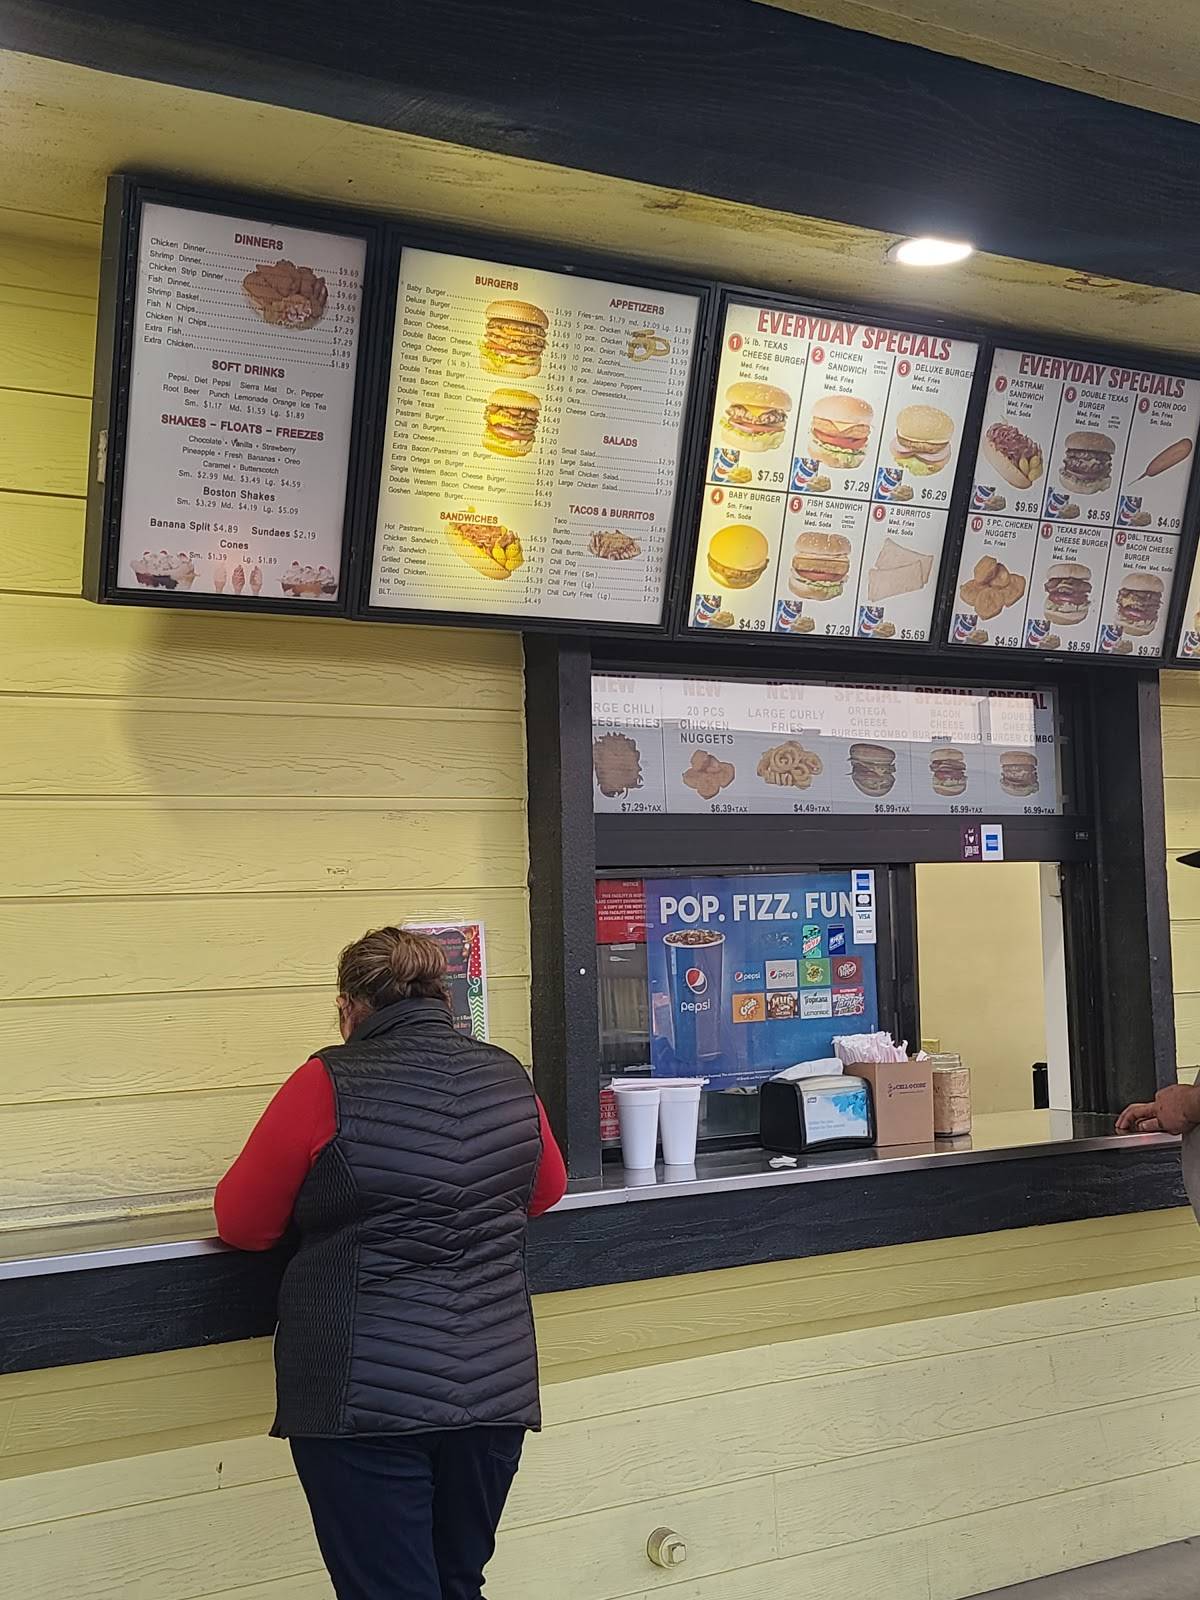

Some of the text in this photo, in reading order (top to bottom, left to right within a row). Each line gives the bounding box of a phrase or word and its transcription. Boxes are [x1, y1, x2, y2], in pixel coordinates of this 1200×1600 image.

[151, 238, 206, 253] Chicken Dinner
[235, 234, 283, 250] DINNERS
[150, 250, 201, 264] Shrimp Dinner
[149, 263, 223, 280] Chicken Strip Dinner
[475, 276, 518, 291] BURGERS
[407, 284, 445, 296] Baby Burger
[147, 300, 161, 309] Fish
[176, 303, 195, 313] Chips
[610, 299, 664, 315] APPETIZERS
[405, 307, 449, 319] Double Burger
[757, 310, 951, 361] EVERYDAY SPECIALS
[144, 337, 193, 349] Extra Chicken
[732, 337, 738, 348] 1
[752, 338, 760, 347] lb.
[764, 340, 788, 351] TEXAS
[742, 350, 805, 365] CHEESE BURGER
[814, 350, 863, 363] 2 CHICKEN
[212, 360, 284, 378] SOFT DRINKS
[741, 362, 769, 371] Med. Fries
[828, 363, 867, 376] SANDWICH
[900, 364, 974, 379] 3 DELUXE BURGER
[739, 371, 768, 381] Med. Soda
[1019, 354, 1185, 398] EVERYDAY SPECIALS
[999, 380, 1044, 390] 7 PASTRAMI
[1009, 390, 1043, 401] SANDWICH
[1068, 390, 1128, 403] 8 DOUBLE TEXAS
[1079, 401, 1105, 411] BURGER
[1142, 401, 1186, 412] 9 CORN DOG
[161, 414, 324, 441] SHAKES FLOATS FREEZES
[394, 431, 435, 442] Extra Cheese
[603, 435, 637, 447] SALADS
[189, 436, 296, 454] Chocolate Vanilla Strawberry
[562, 448, 576, 456] Small
[758, 470, 783, 482] $7.59
[844, 480, 869, 492] $7.29
[203, 487, 275, 502] Boston Shakes
[714, 491, 780, 503] 4 BABY BURGER
[921, 488, 947, 500] $6.29
[196, 499, 216, 508] $3.29
[221, 502, 234, 510] Md.
[239, 502, 257, 512] $4.19
[263, 505, 273, 514] Lg.
[279, 506, 298, 515] $5.09
[793, 499, 863, 511] 5 FISH SANDWICH
[1015, 502, 1038, 513] $9.69
[440, 512, 498, 524] SANDWICHES
[569, 505, 654, 520] TACOS & BURRITOS
[877, 509, 882, 518] 6
[896, 509, 931, 518] BURRITOS
[1088, 510, 1110, 521] $8.59
[150, 519, 238, 533] Banana Split $4.89
[399, 524, 424, 532] Pastrami
[972, 520, 981, 529] 10
[1005, 521, 1033, 530] CHICKEN
[1158, 517, 1180, 528] $4.09
[252, 527, 316, 540] Sundaes $2.19
[985, 529, 1016, 539] NUGGETS
[1043, 526, 1101, 537] 11 TEXAS BACON
[220, 540, 248, 550] Cones
[1055, 536, 1108, 548] CHEESE BURGER
[1116, 535, 1125, 544] 12
[1142, 535, 1163, 543] TEXAS
[399, 546, 427, 554] Sandwich
[1126, 544, 1174, 555] BACON CHEESE
[1124, 553, 1150, 562] BURGER
[739, 618, 765, 630] $4.39
[826, 624, 850, 635] $7.29
[901, 629, 925, 640] $5.69
[995, 636, 1018, 646] $4.59
[1067, 641, 1090, 651] $8.59
[1138, 646, 1160, 656] $9.79
[623, 704, 654, 715] CHILI
[687, 707, 725, 717] 20 PCS
[748, 708, 824, 719] LARGE CURLY
[848, 706, 887, 716] ORTEGA
[625, 718, 660, 728] FRIES
[680, 719, 729, 730] CHICKEN
[772, 722, 803, 732] FRIES
[851, 718, 887, 727] CHEESE
[832, 728, 908, 738] BURGER COMBO
[680, 734, 734, 744] NUGGETS
[660, 894, 725, 924] POP.
[733, 892, 798, 921] FIZZ.
[806, 891, 853, 918] FUN
[744, 972, 760, 982] pepsi
[778, 969, 794, 979] pepsi
[772, 993, 794, 1006] MUG
[804, 995, 828, 1006] Tropicana
[680, 1000, 711, 1014] pepsi
